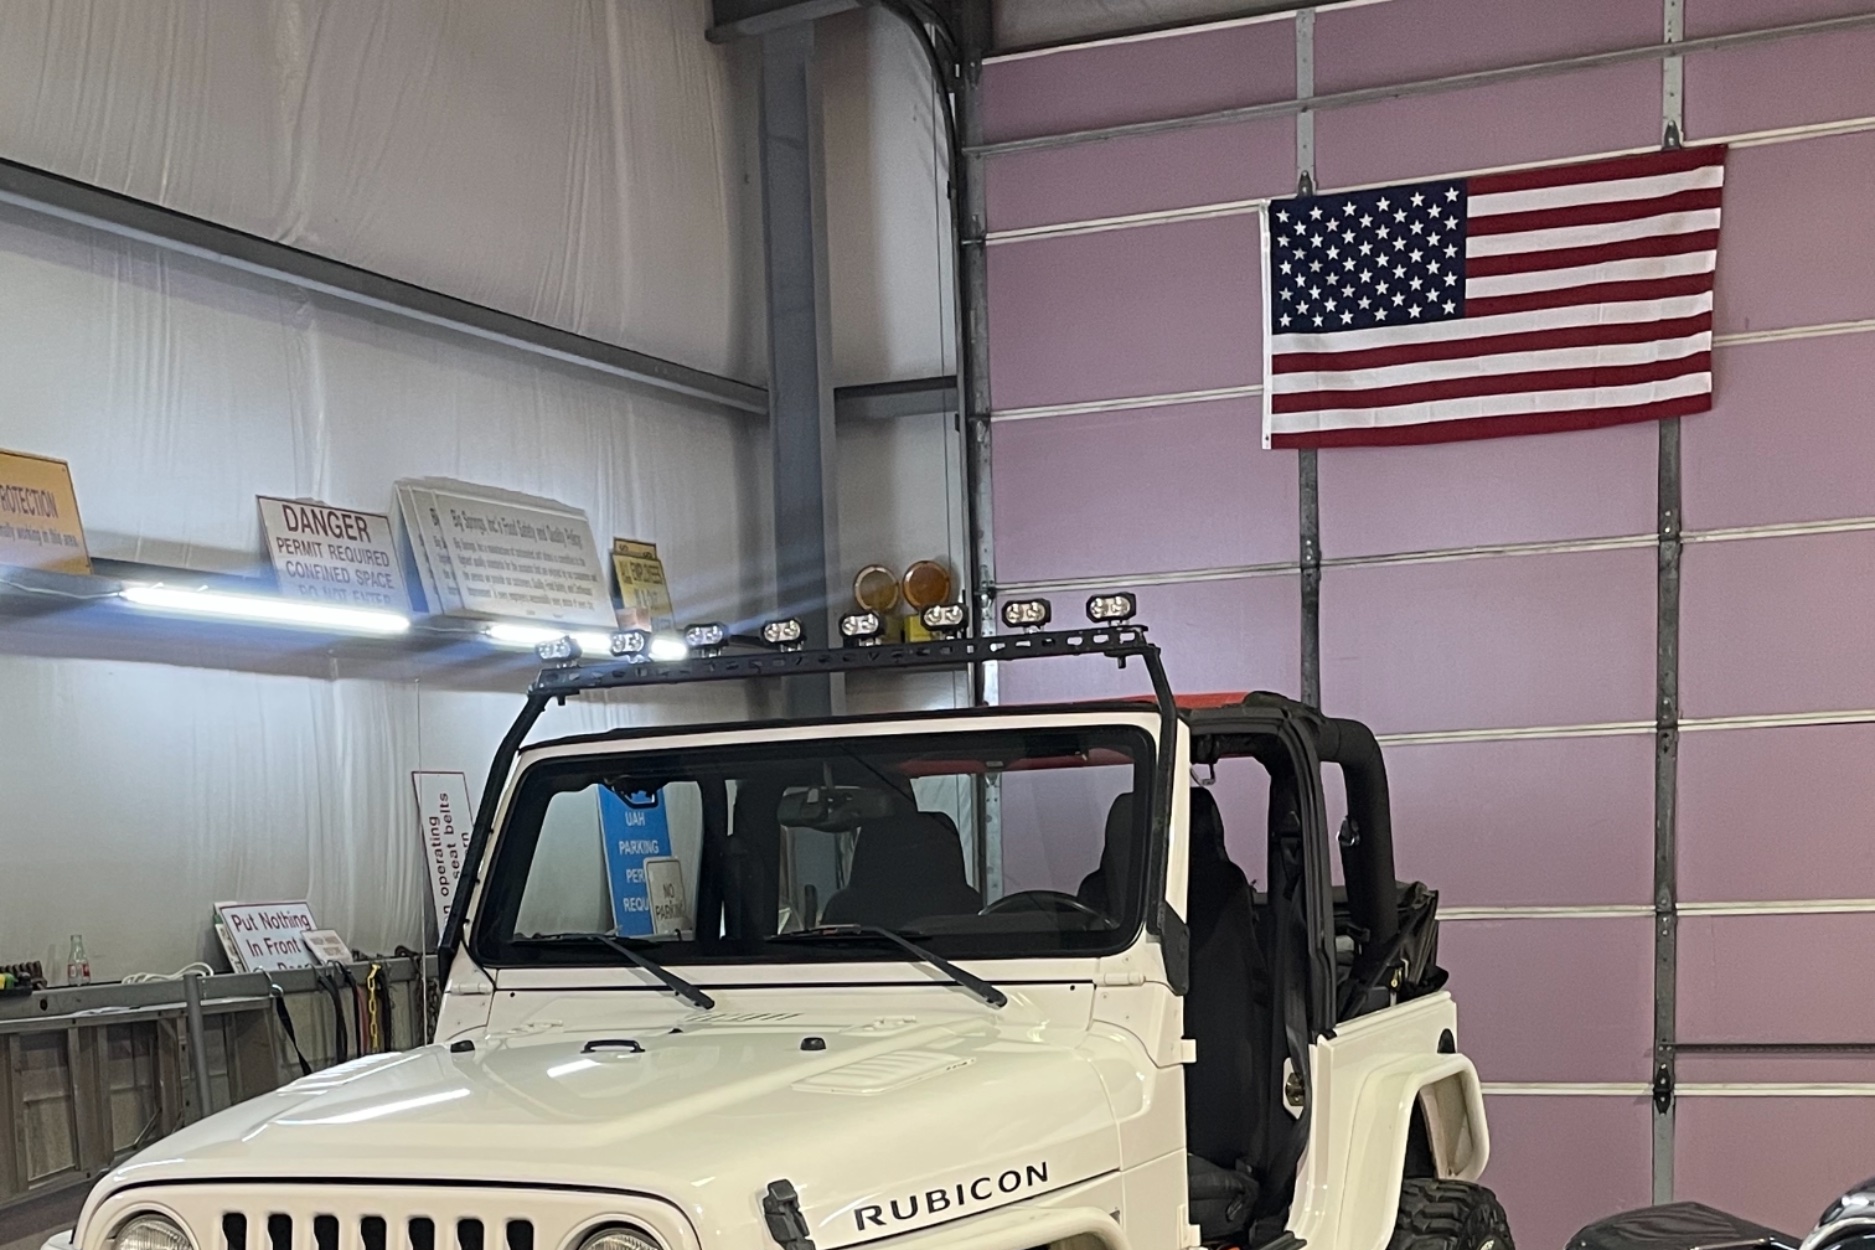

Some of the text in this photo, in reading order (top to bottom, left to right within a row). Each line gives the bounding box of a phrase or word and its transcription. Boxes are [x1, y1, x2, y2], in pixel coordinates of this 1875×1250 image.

[0, 484, 58, 518] ROTECTION
[282, 504, 371, 543] DANGER
[276, 537, 390, 567] PERMIT REQUIRED
[286, 560, 395, 589] CONFINED SPACE
[625, 811, 645, 827] UAH
[440, 793, 461, 880] seat belts
[619, 840, 659, 855] PARKING
[429, 816, 450, 897] operating
[626, 868, 645, 883] PER
[662, 882, 675, 898] NO
[623, 897, 649, 912] REQU
[231, 910, 312, 932] Put Nothing
[246, 940, 263, 957] In
[264, 938, 301, 955] Front
[854, 1162, 1048, 1231] RUBICON
